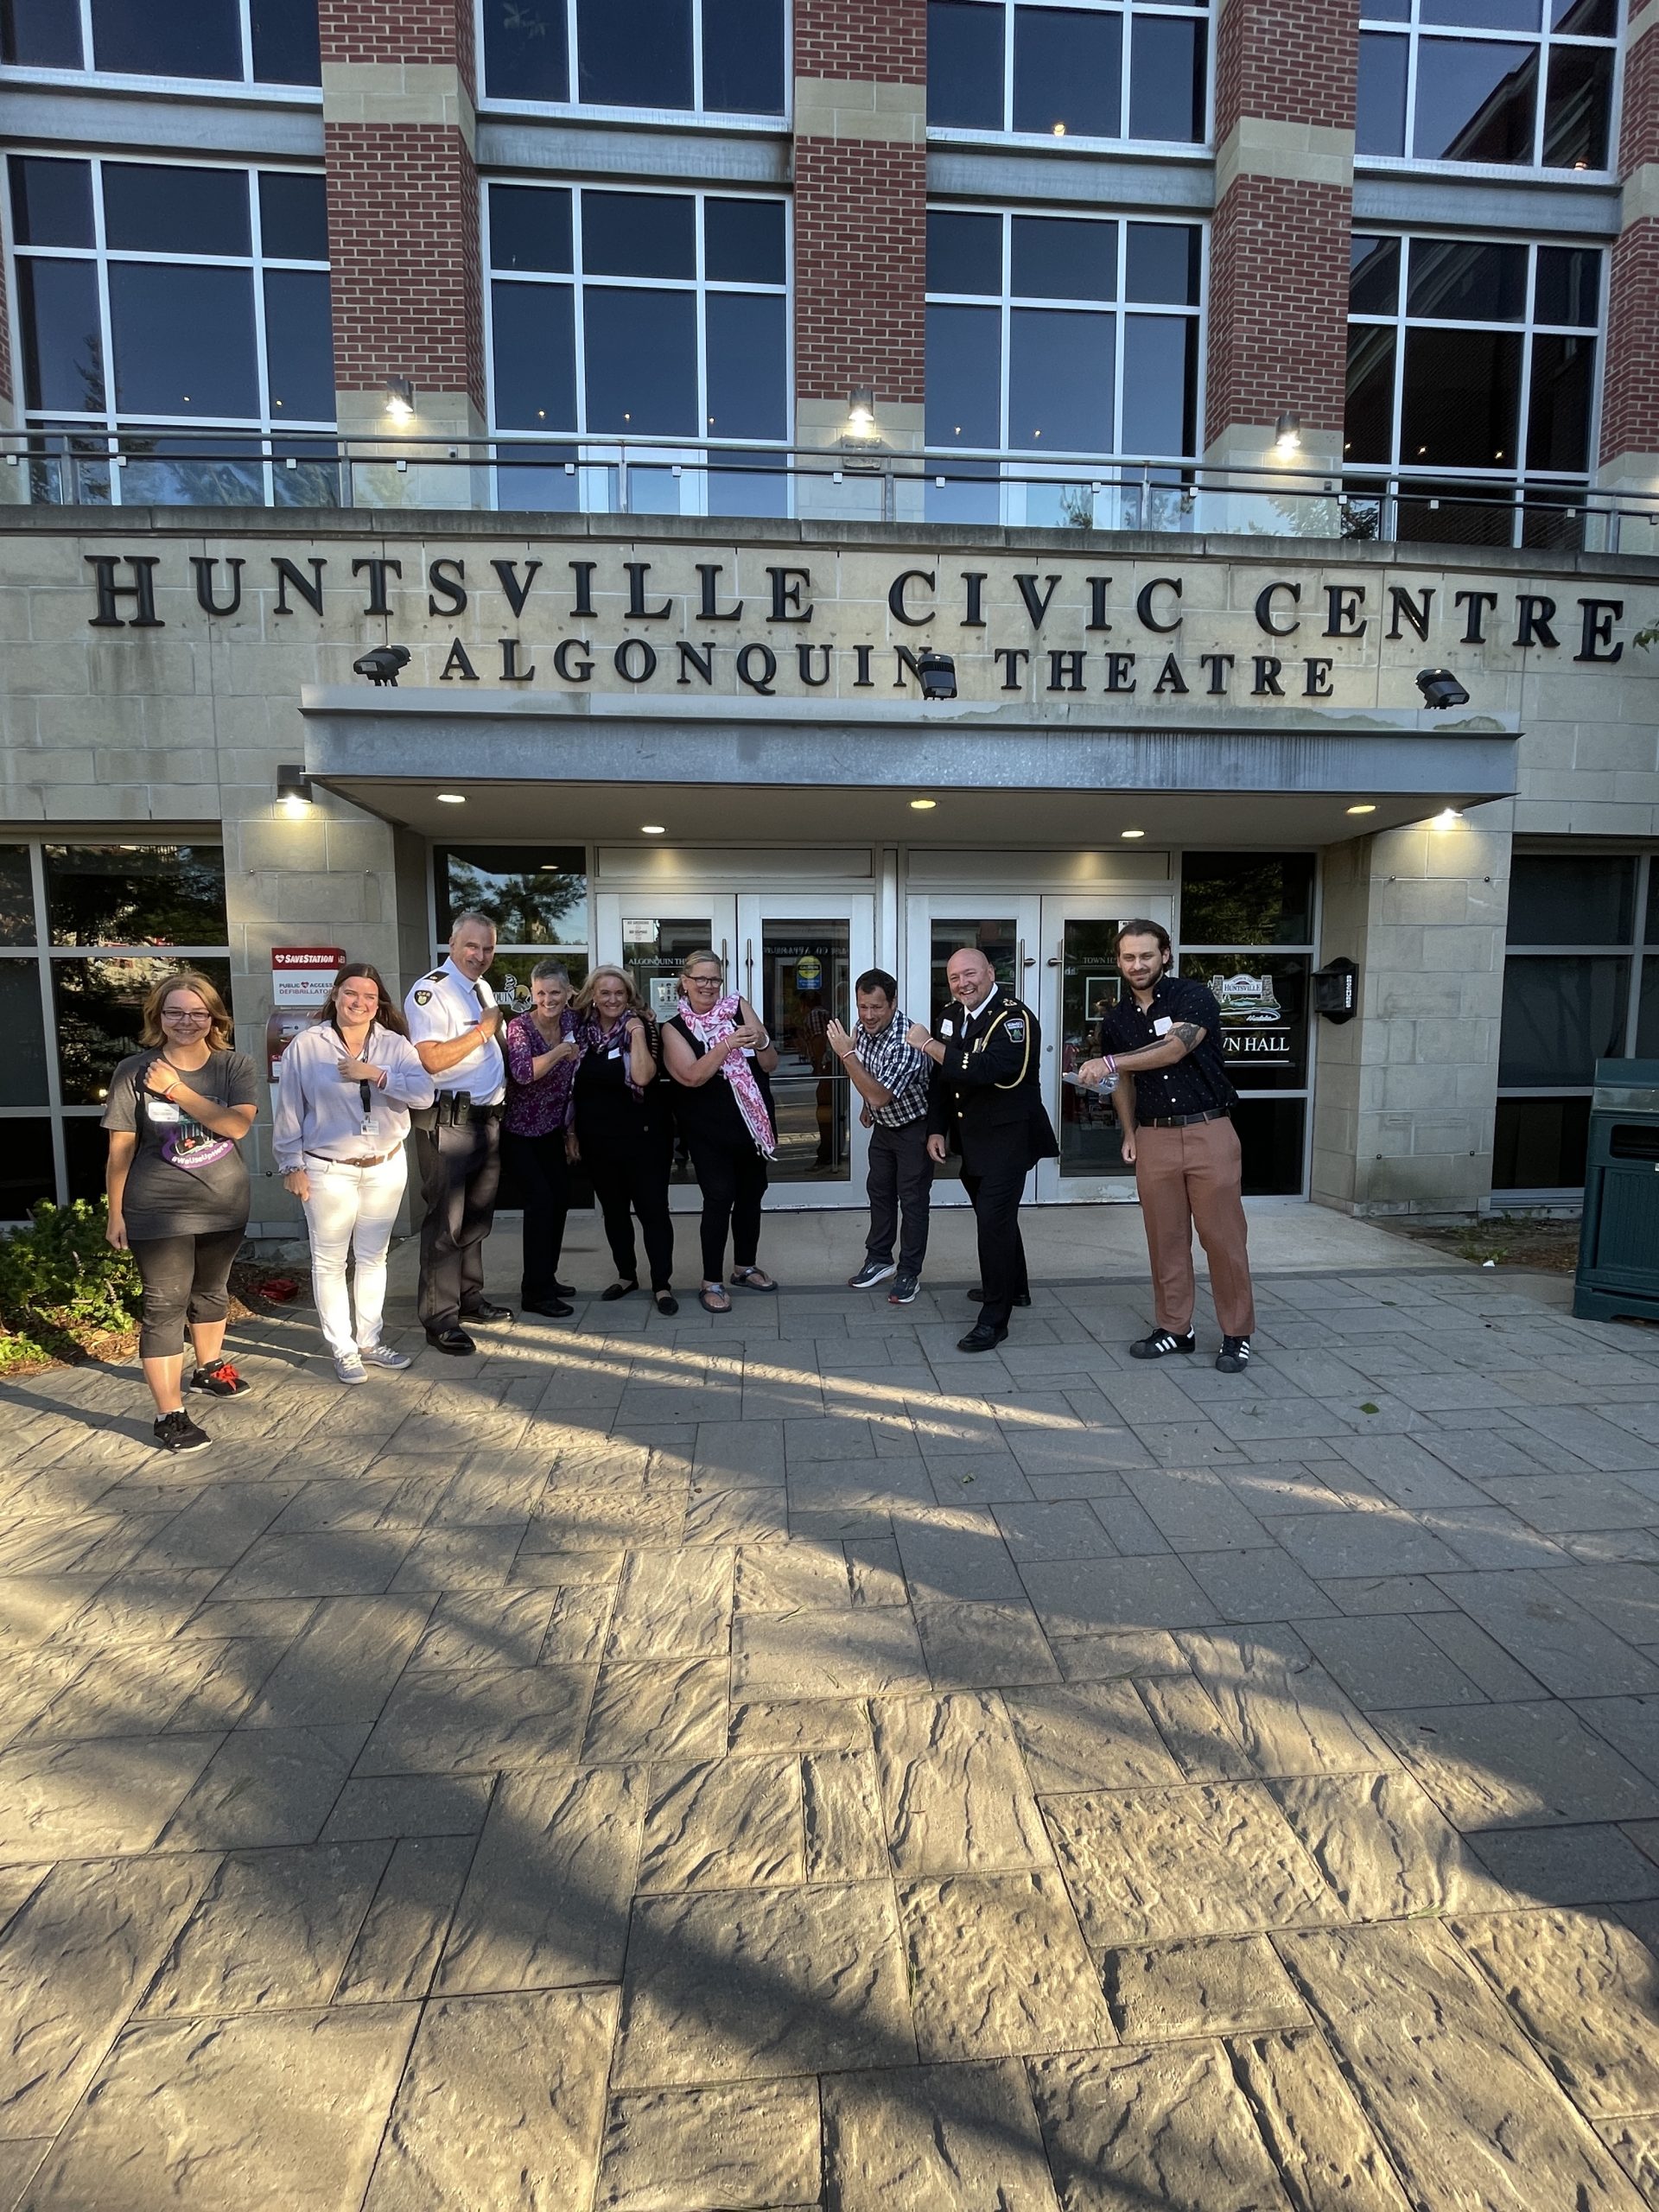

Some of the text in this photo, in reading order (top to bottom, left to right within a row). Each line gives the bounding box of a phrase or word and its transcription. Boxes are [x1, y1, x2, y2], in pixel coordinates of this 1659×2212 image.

[84, 555, 1624, 662] HUNTSVILLE CIVIC CENTRE
[439, 637, 1334, 696] ALGONQUIN THEATRE
[628, 956, 674, 965] ALGONQUIN
[1224, 983, 1262, 992] HUNTSVILLE
[1244, 1037, 1290, 1052] HALL
